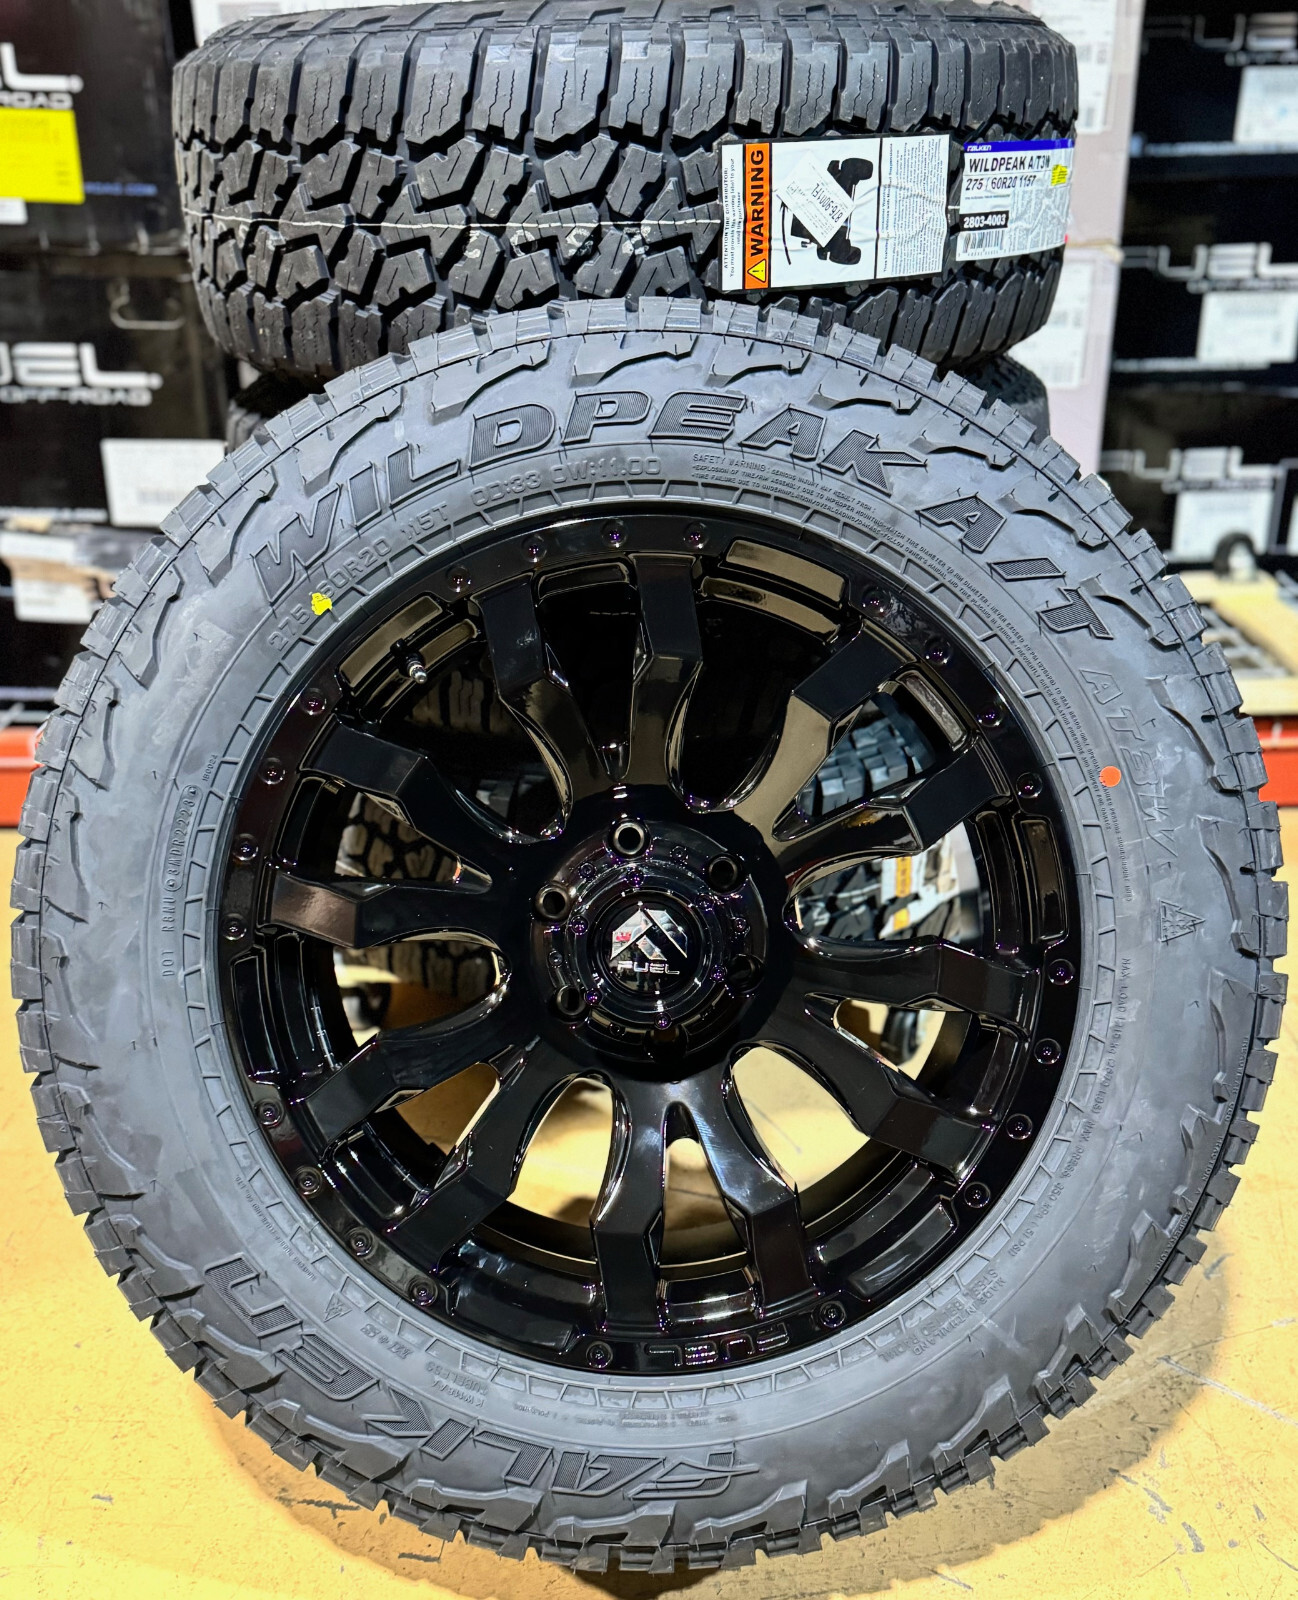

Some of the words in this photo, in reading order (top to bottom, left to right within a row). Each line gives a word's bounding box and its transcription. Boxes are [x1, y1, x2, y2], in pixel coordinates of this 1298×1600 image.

[1139, 12, 1298, 55] FUE
[969, 156, 1027, 172] WILDPEAK
[966, 178, 984, 190] 275
[991, 176, 1016, 190] 60R20
[748, 149, 765, 256] WARNING
[964, 214, 1006, 228] 2803-4003
[692, 453, 725, 465] SAFETY
[251, 389, 929, 604] WILDPEAK
[815, 491, 824, 499] TO
[266, 533, 393, 653] 27560R20
[160, 950, 175, 976] DOT
[617, 960, 680, 975] FUEL
[962, 1266, 999, 1303] STEEL
[976, 1275, 1007, 1305] MADE
[918, 1298, 965, 1338] BELTED
[963, 1302, 978, 1317] IN
[910, 1312, 967, 1357] THAILAND
[205, 1252, 760, 1500] FALKEN
[423, 1359, 490, 1396] TUBELESS
